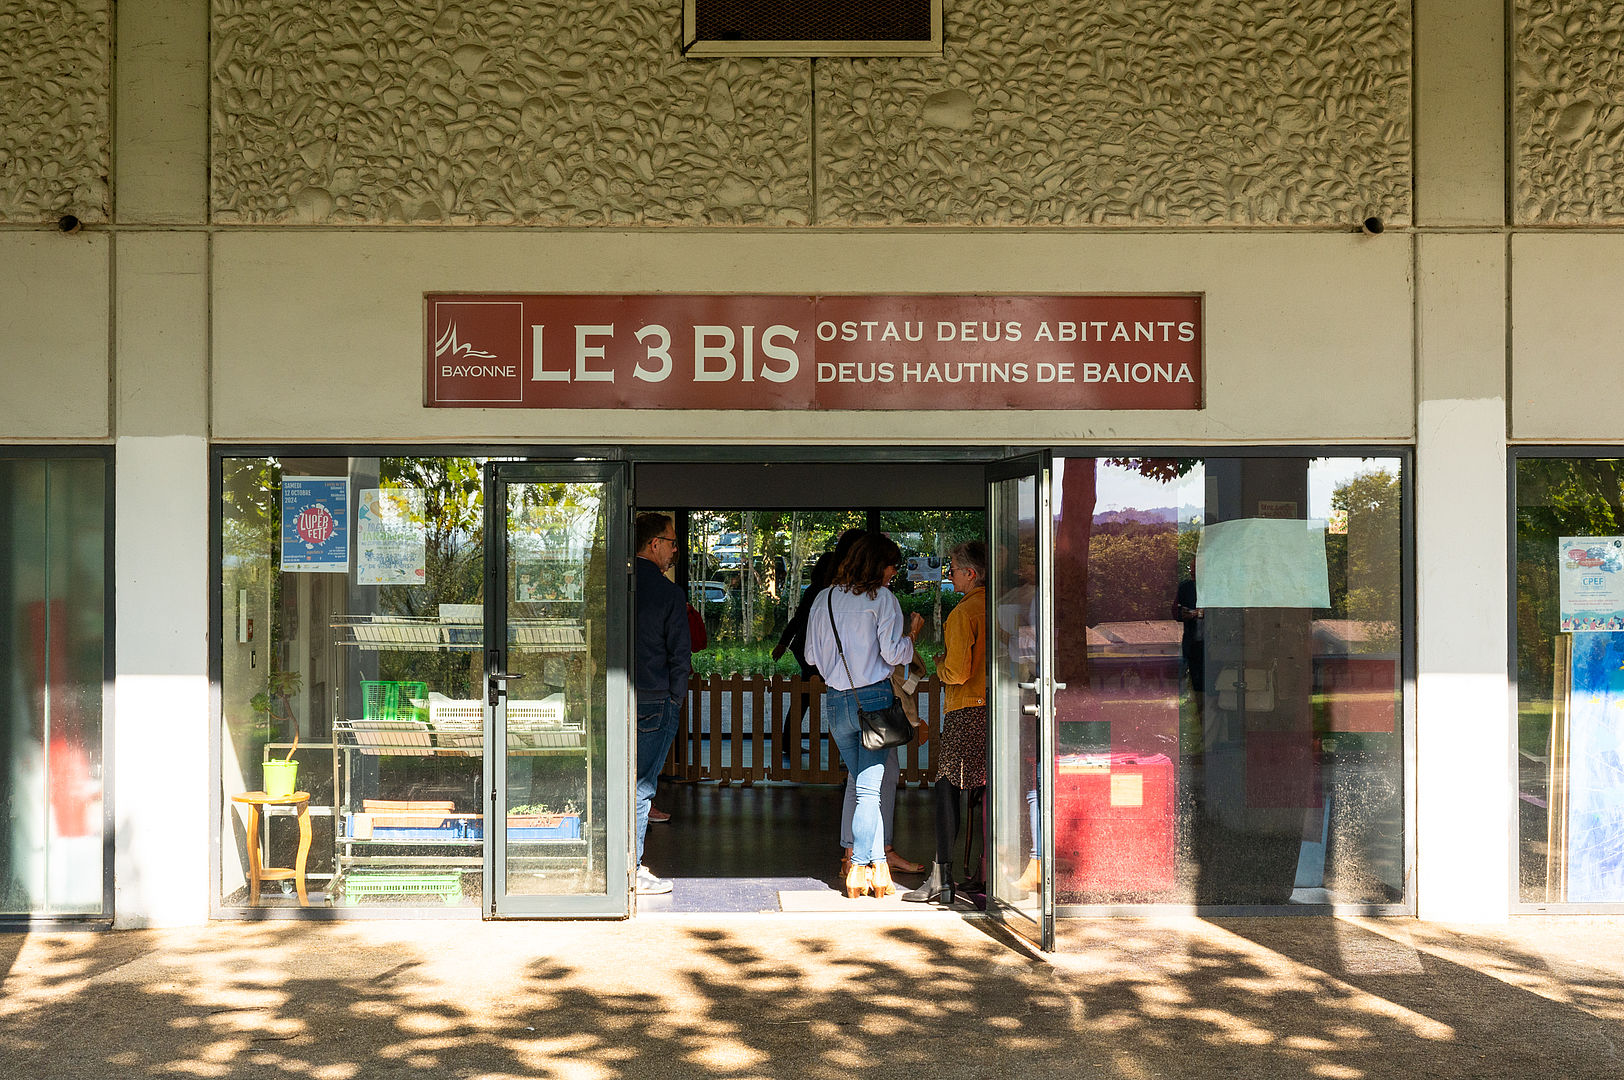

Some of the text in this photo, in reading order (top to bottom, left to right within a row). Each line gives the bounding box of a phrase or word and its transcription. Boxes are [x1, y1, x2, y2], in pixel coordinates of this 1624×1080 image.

[816, 321, 1195, 342] OSTAU DEUS ABITANTS
[530, 323, 800, 384] LE 3 BIS
[441, 365, 517, 377] BAYONNE
[817, 362, 1195, 383] DEUS HAUTINS DE BAIONA
[1583, 577, 1604, 585] CPEF
